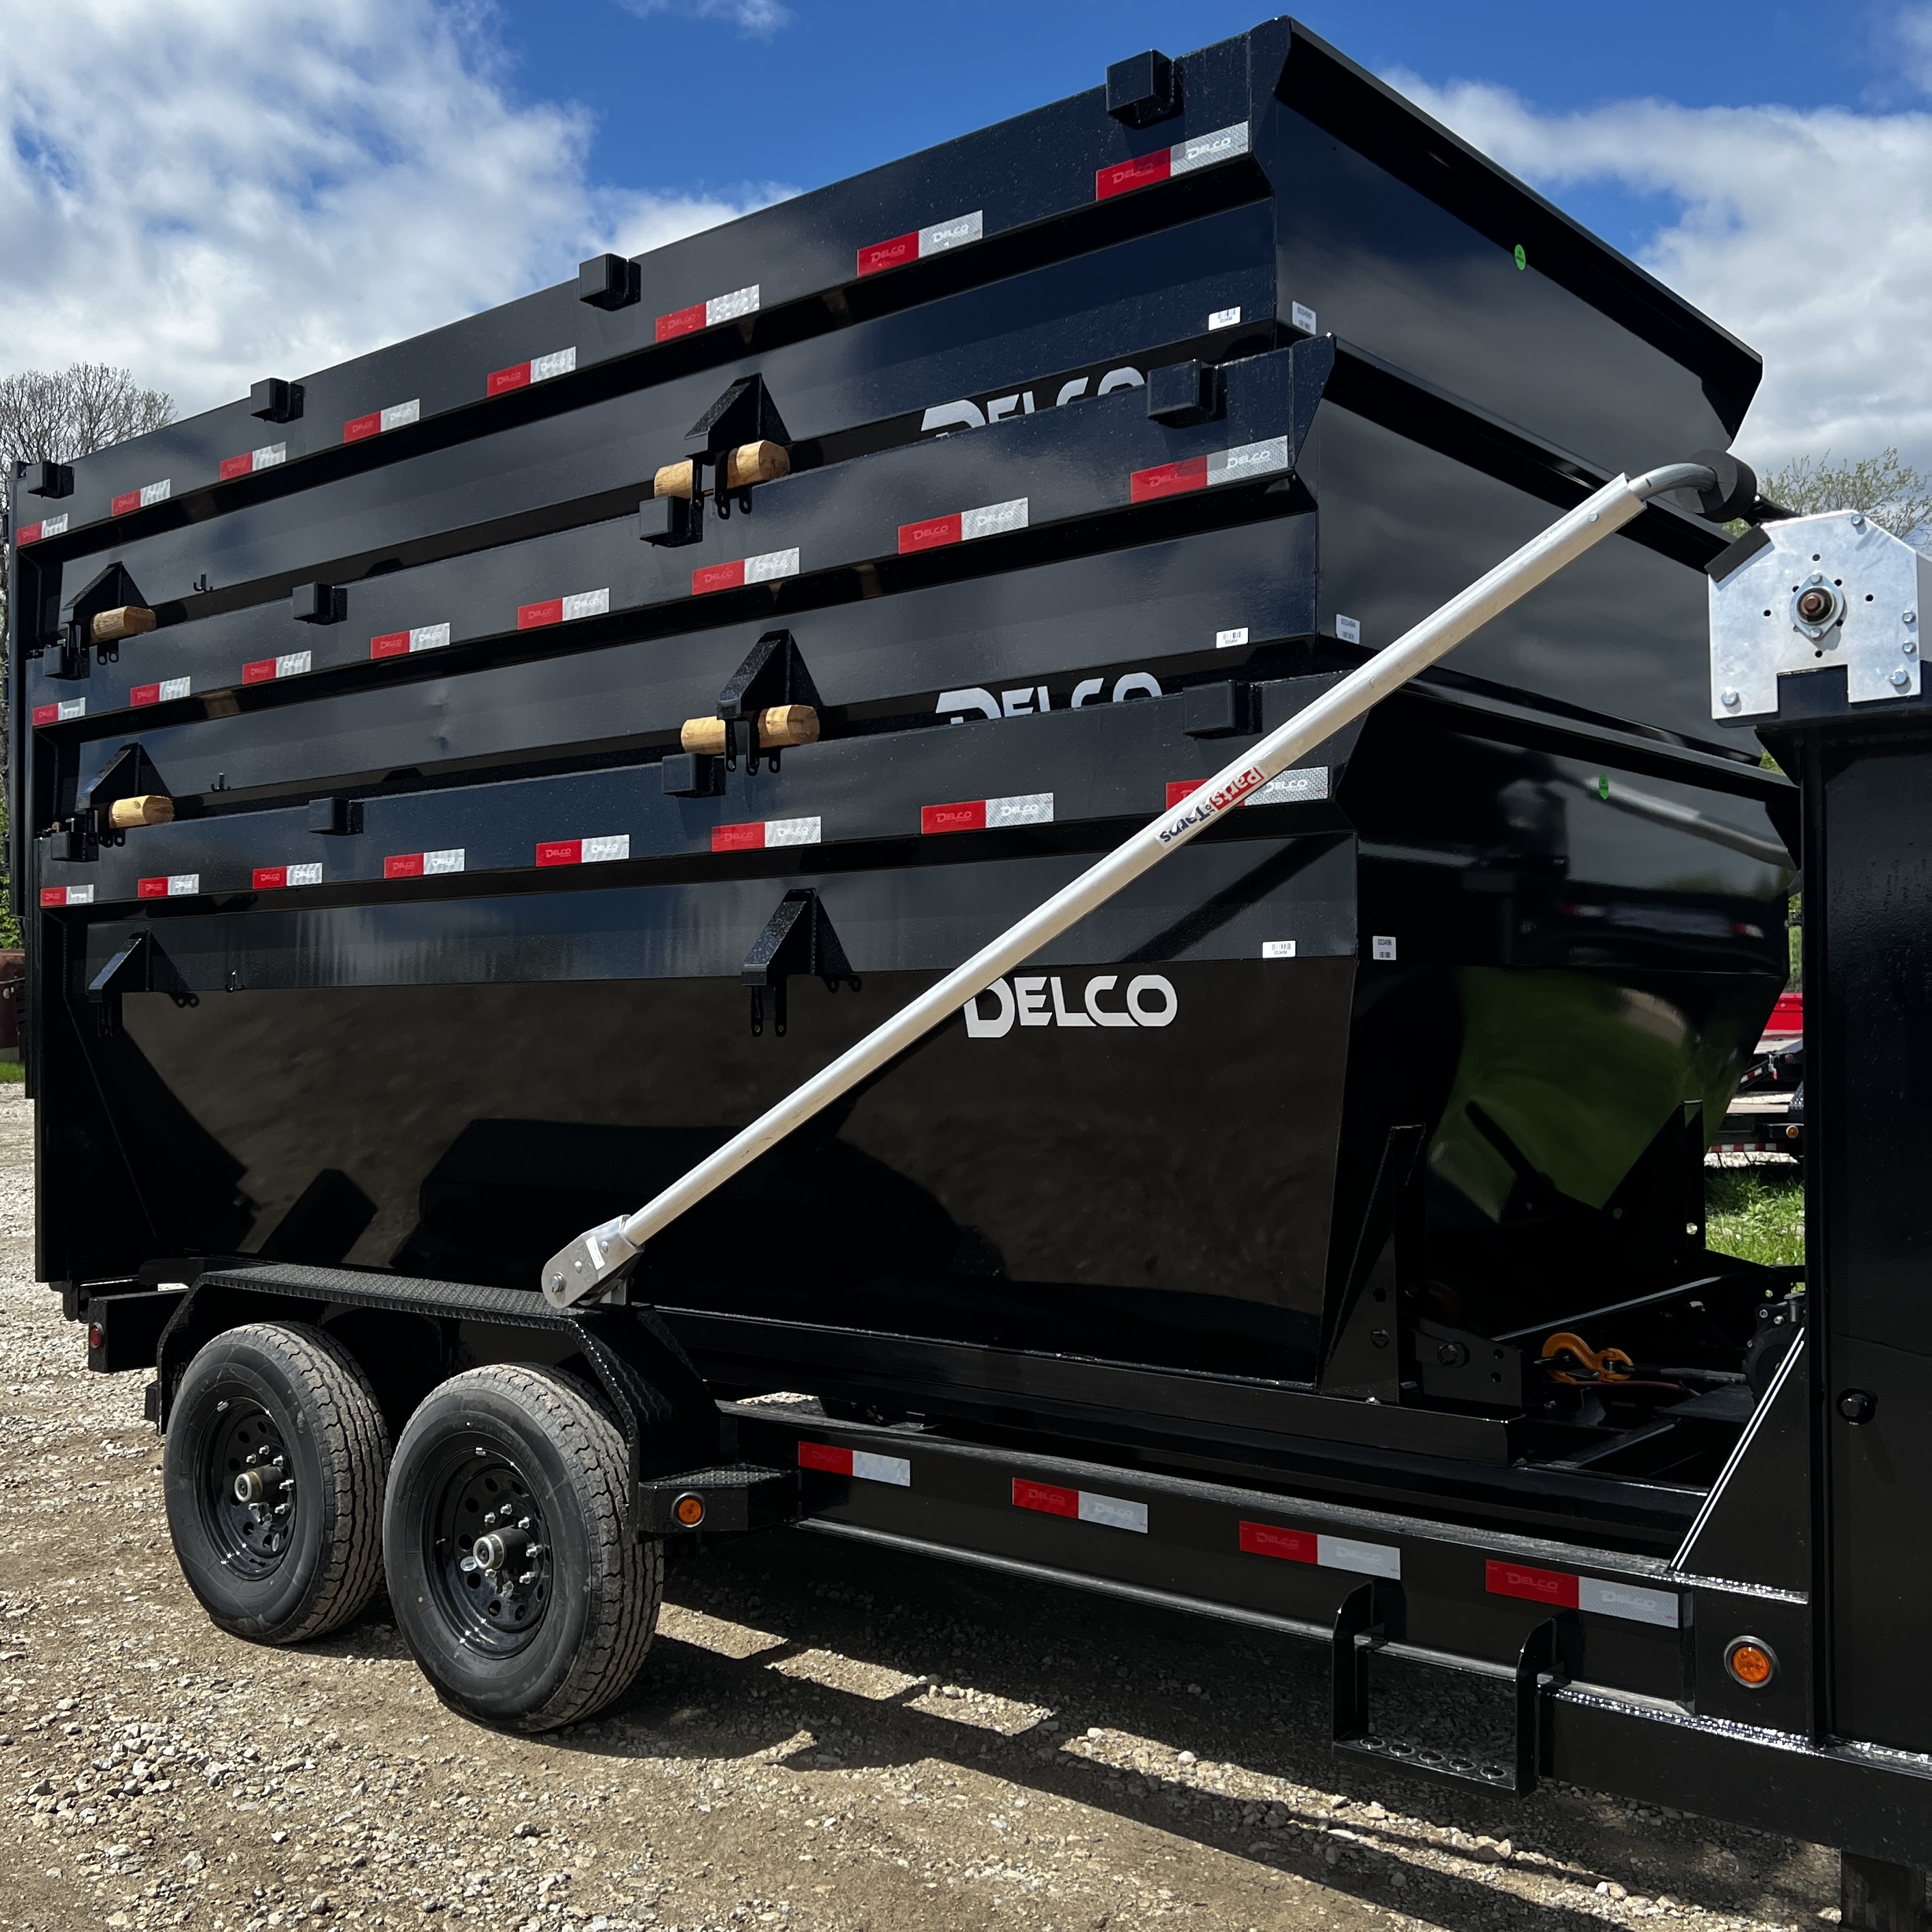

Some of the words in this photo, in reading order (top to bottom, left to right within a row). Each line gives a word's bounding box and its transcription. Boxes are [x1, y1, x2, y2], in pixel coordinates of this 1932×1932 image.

[1112, 162, 1155, 184] DELCO
[1185, 137, 1231, 160] DELCO
[870, 244, 905, 264] DELCO
[933, 224, 969, 243] DELCO
[666, 314, 696, 330] DELCO
[496, 372, 521, 386] DELCO
[352, 421, 374, 433] DELCO
[1149, 473, 1182, 488] DELC
[1226, 450, 1270, 469] DELCO
[913, 525, 949, 540] DELCO
[975, 510, 1014, 527] DELCO
[703, 570, 733, 584] DELCO
[527, 607, 553, 619] DELCO
[379, 639, 402, 649] DELCO
[1211, 767, 1264, 807] Parts
[1264, 779, 1309, 794] DELCO
[936, 811, 973, 824] DELCO
[1001, 803, 1039, 816] DELCO
[723, 831, 753, 842] DELCO
[776, 826, 809, 838] DELCO
[545, 848, 571, 858] DELCO
[591, 844, 618, 854] DELCO
[392, 861, 416, 870] DELCO
[432, 857, 455, 866] DELCO
[260, 873, 281, 881] DELCO
[294, 870, 316, 879] DELCO
[964, 975, 1178, 1038] DELCO
[1027, 1488, 1066, 1504] DELCO
[1092, 1502, 1133, 1518] DELCO
[1255, 1531, 1299, 1548] DELCO
[1334, 1545, 1382, 1561] DELCO
[1504, 1572, 1558, 1590] DELCO
[1597, 1589, 1655, 1609] DELCO
